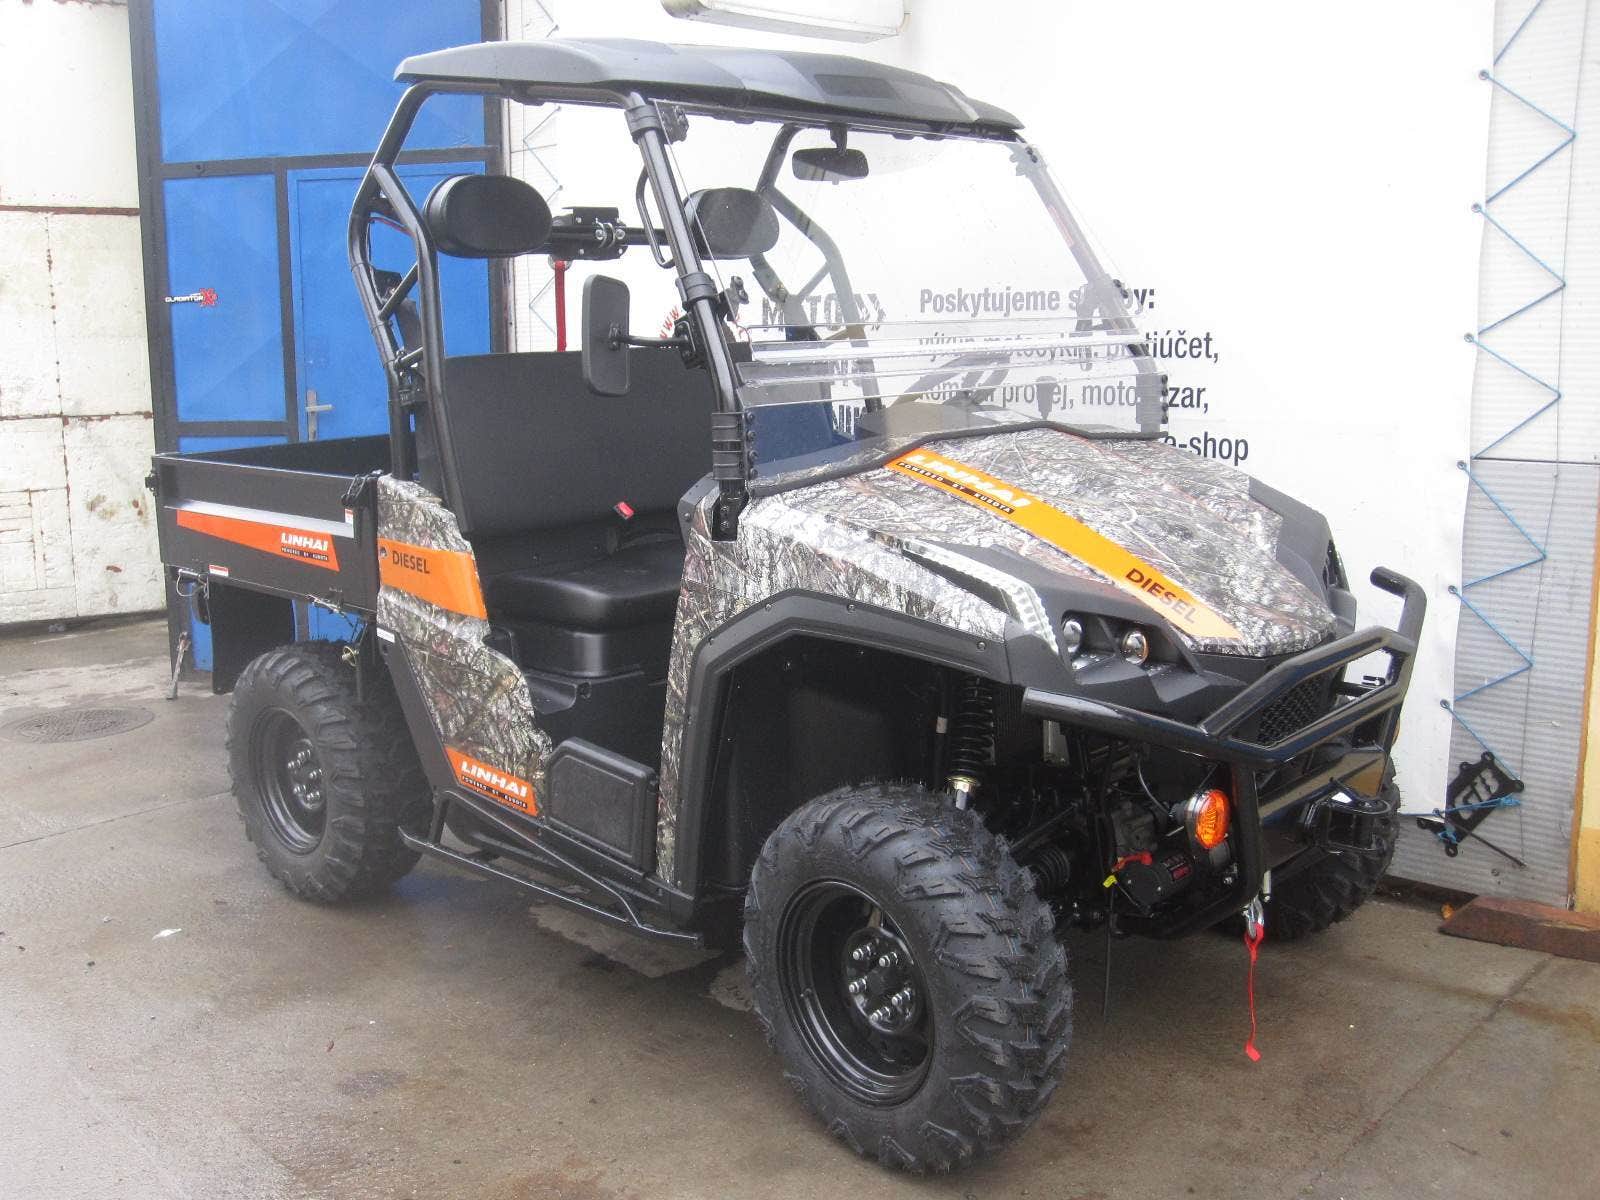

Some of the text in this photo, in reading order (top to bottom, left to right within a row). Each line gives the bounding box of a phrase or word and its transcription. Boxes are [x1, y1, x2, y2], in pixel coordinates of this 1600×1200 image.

[920, 286, 1061, 318] Poskytujeme
[1002, 380, 1074, 411] proej,
[1082, 380, 1209, 413] motozar,
[898, 461, 1012, 514] POWERED BY KUBOTA
[904, 454, 1032, 508] LINHAI
[280, 532, 329, 551] LINHAI
[392, 550, 431, 574] DIESEL
[1126, 567, 1197, 624] DIESEL
[461, 761, 528, 798] LINHAI
